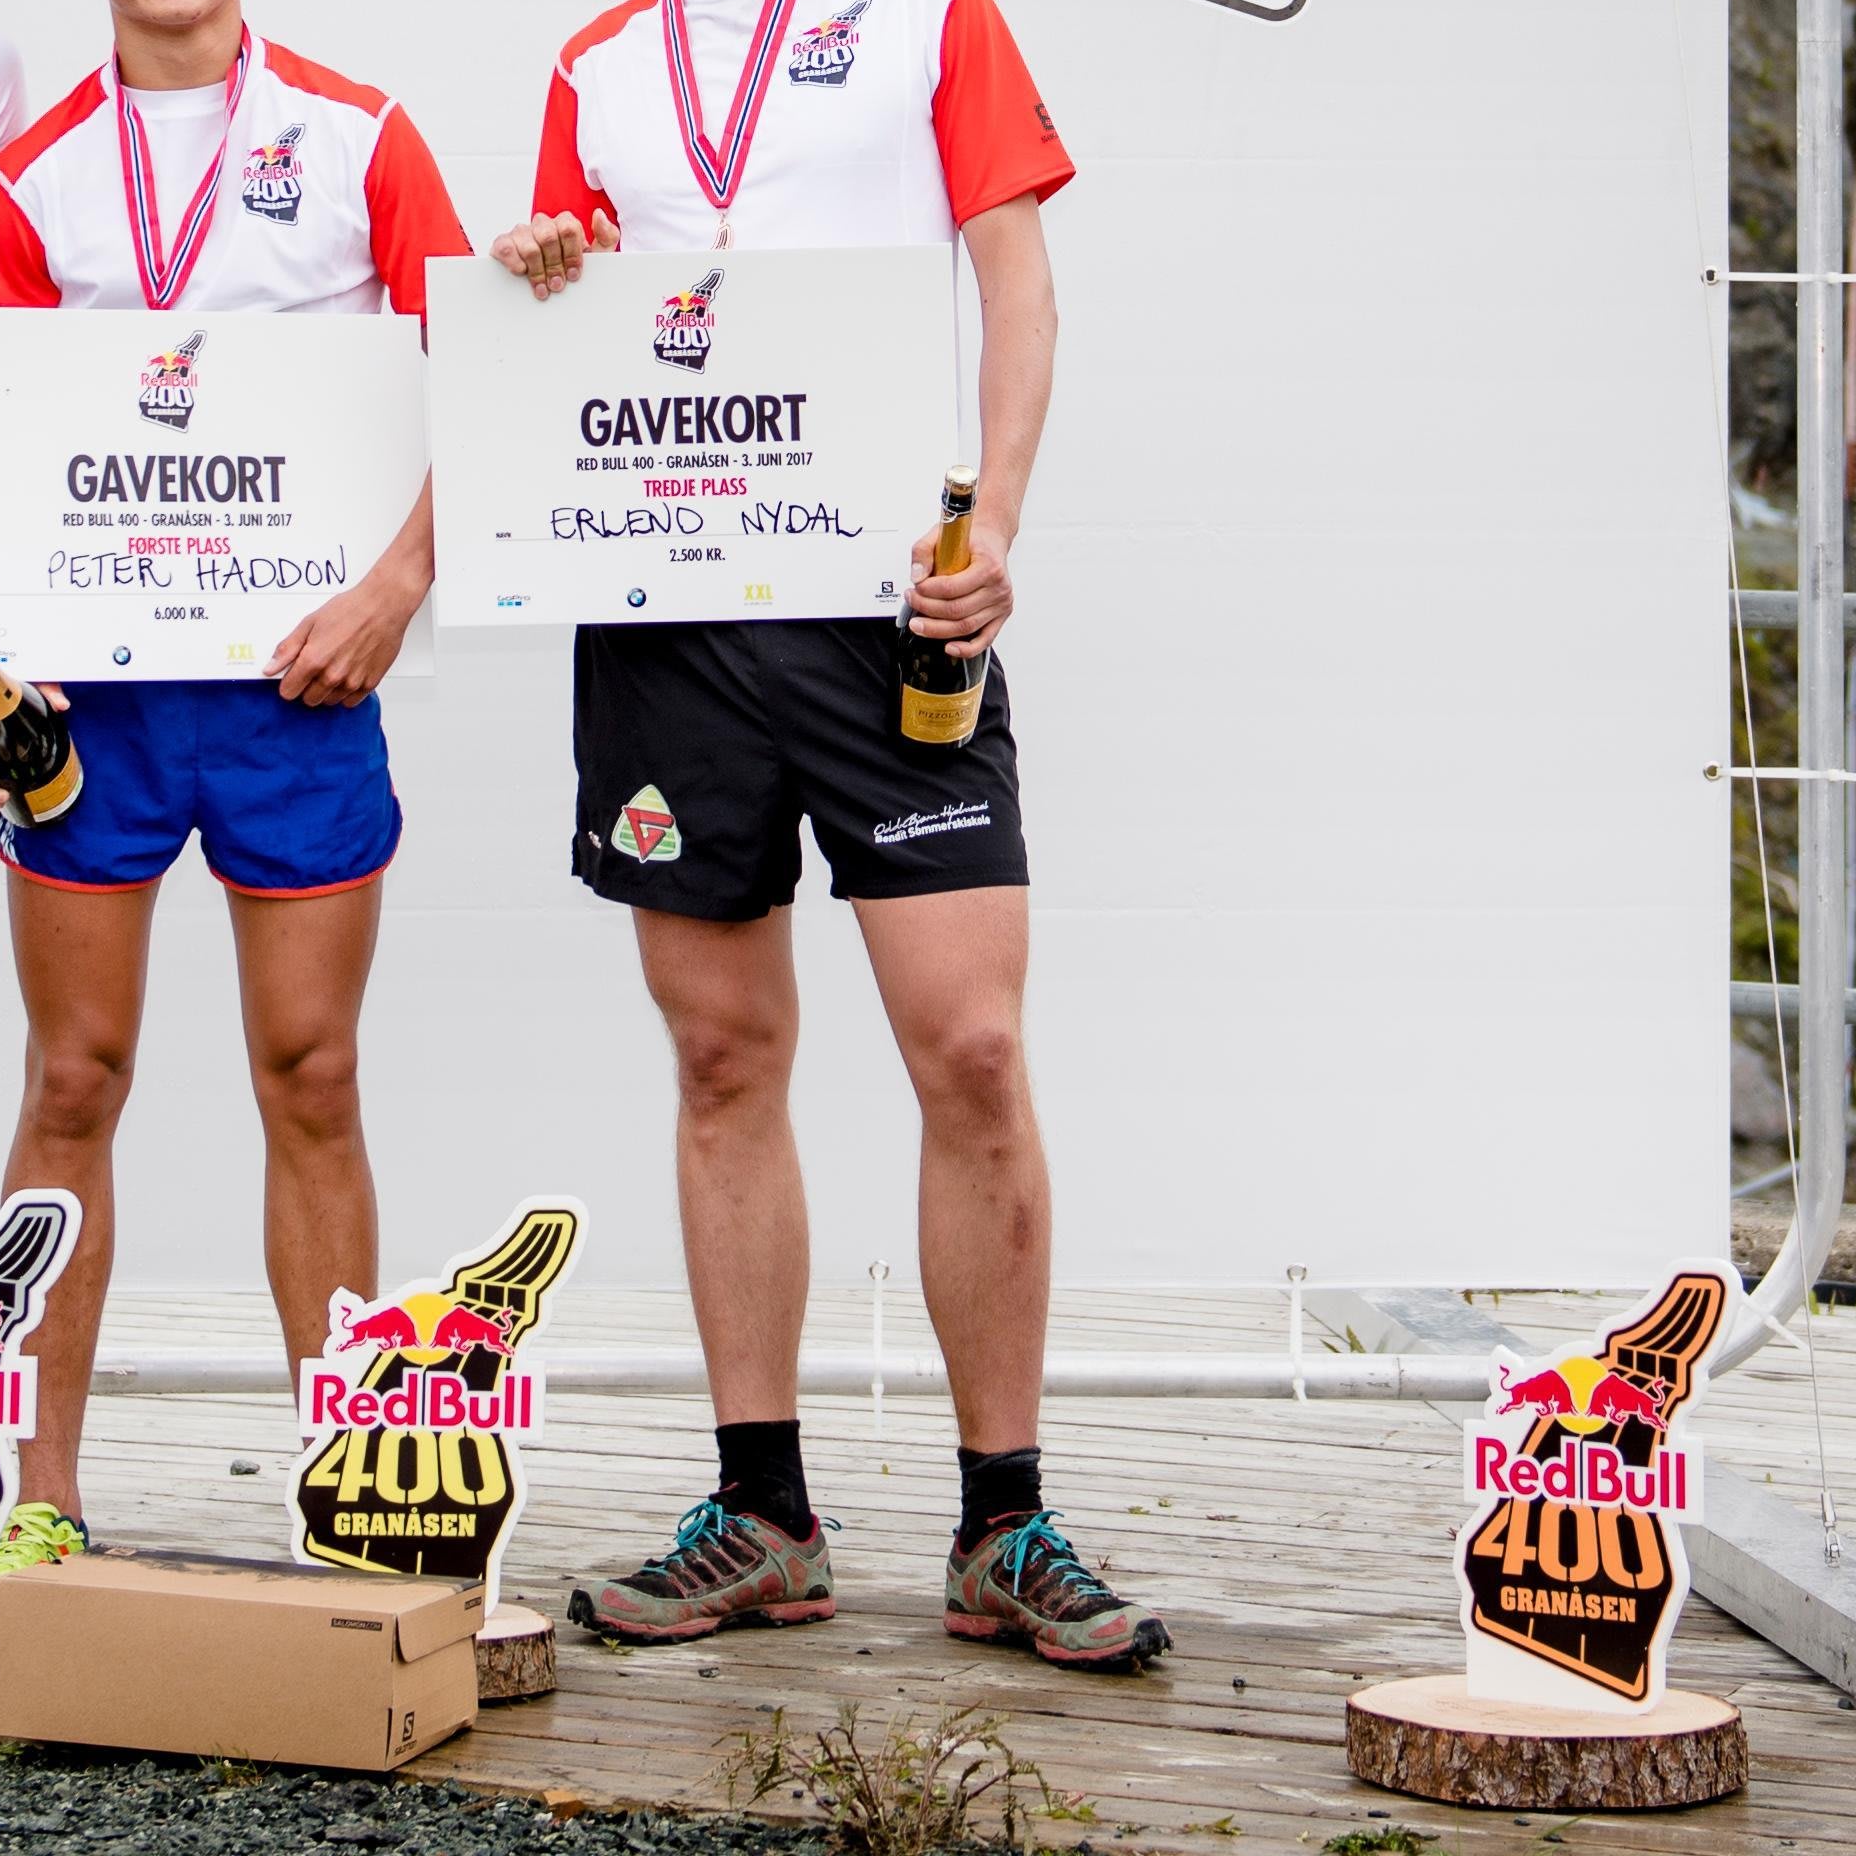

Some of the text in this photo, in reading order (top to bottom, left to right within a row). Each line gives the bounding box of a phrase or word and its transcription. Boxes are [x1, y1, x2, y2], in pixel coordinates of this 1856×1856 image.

[790, 45, 853, 70] 400
[244, 178, 300, 201] 400
[656, 312, 715, 327] Red Bull
[655, 326, 710, 348] 400
[140, 385, 193, 407] 400
[580, 394, 807, 447] GAVEKORT
[576, 457, 598, 471] RED
[602, 456, 628, 470] BULL
[632, 455, 654, 469] 400
[666, 451, 729, 468] GRANÅSEN
[741, 453, 752, 467] 3.
[756, 453, 782, 467] JUNI
[786, 452, 813, 466] 2017
[67, 454, 286, 503] GAVEKORT
[643, 477, 747, 498] TREDJE PLASS
[63, 513, 84, 526] RED
[88, 513, 113, 526] BULL
[118, 513, 139, 526] 400
[151, 510, 212, 526] GRANÅSEN
[224, 513, 234, 526] 3.
[238, 513, 262, 526] JUNI
[267, 513, 292, 526] 2017
[742, 501, 863, 537] NYDAL
[128, 537, 231, 555] FØRSTE PLASS
[670, 548, 726, 562] 2.500 KR.
[48, 544, 346, 593] PETER HADDON
[744, 584, 774, 601] XXL
[154, 607, 209, 620] 6.000 KR.
[227, 643, 255, 660] XXL
[312, 1373, 532, 1430] Red Bull
[306, 1429, 507, 1505] 400
[1474, 1437, 1686, 1511] Red Bull
[334, 1506, 477, 1537] GRANÅSEN
[1472, 1498, 1665, 1590] 400
[1500, 1585, 1637, 1624] GRANÅSEN
